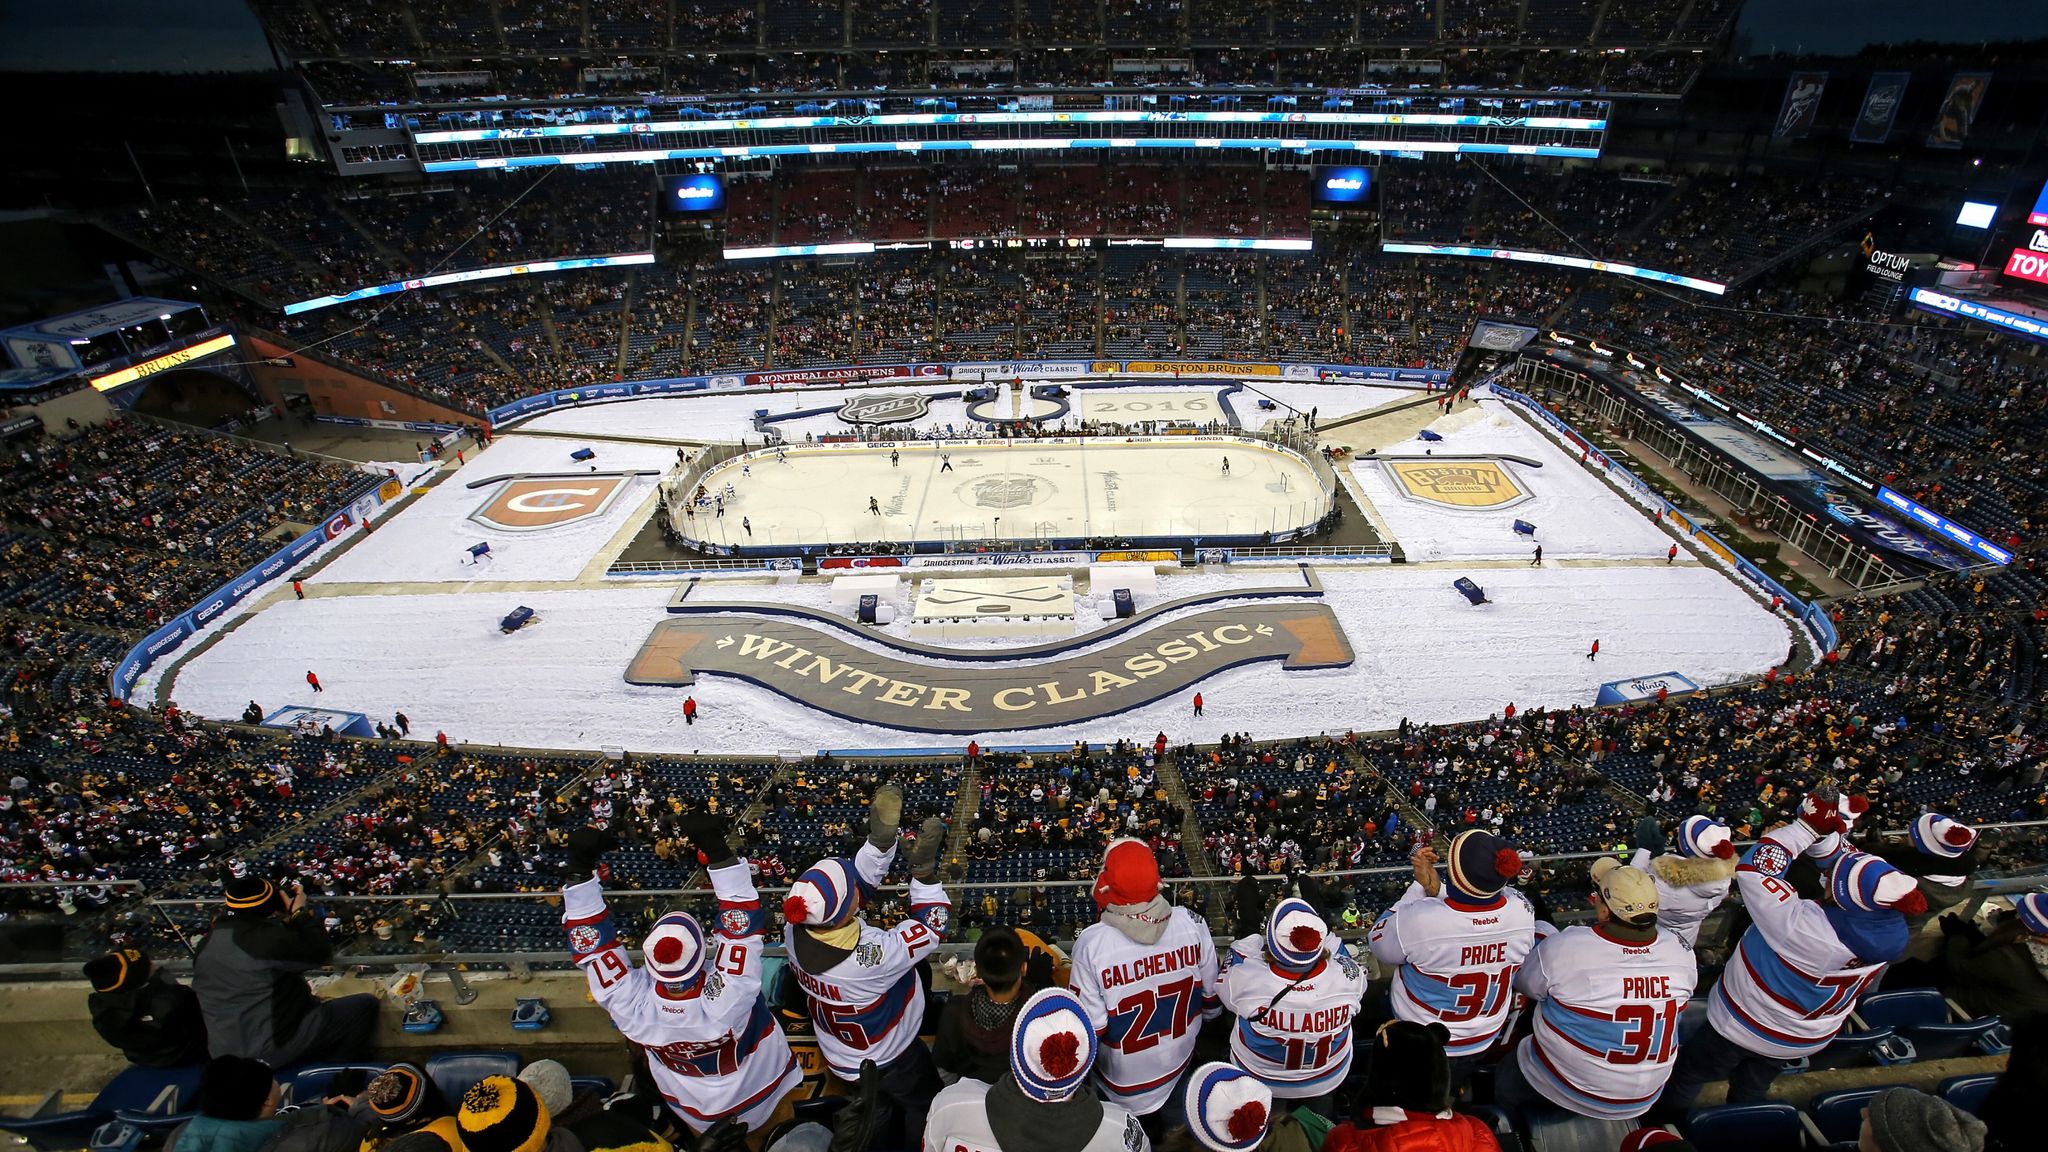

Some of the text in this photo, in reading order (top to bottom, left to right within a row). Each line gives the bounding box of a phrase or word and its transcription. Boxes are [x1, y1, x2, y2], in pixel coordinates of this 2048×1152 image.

[1871, 250, 1910, 272] OPTUM
[1866, 264, 1903, 281] FIELD LOUNGE
[134, 350, 191, 378] BRUINS
[1010, 362, 1044, 374] Winter
[1154, 363, 1253, 374] BOSTON BRUINS
[758, 367, 896, 384] MONTREAL CANADIENS
[857, 399, 912, 417] NHL
[1094, 398, 1209, 413] 2016
[715, 457, 738, 472] DISCOVER
[1408, 468, 1498, 487] BOSTON
[1833, 504, 1931, 553] OPTUM
[262, 558, 286, 577] Reebok
[923, 554, 1075, 567] BRIDGESTONE Winter CLASSIC
[197, 599, 224, 621] GEICO
[147, 627, 183, 655] BRIDGESTONE
[125, 659, 141, 683] Reebok
[734, 622, 1258, 713] WINTER CLASSIC
[1631, 680, 1671, 694] Winter
[1472, 916, 1499, 926] Reebok
[900, 923, 931, 959] 76
[1623, 947, 1651, 955] Reebok
[715, 943, 748, 976] 67
[1460, 942, 1507, 966] PRICE
[592, 949, 629, 990] 67
[1439, 965, 1513, 1022] 31
[1623, 976, 1672, 999] PRICE
[662, 1004, 686, 1015] Reebok
[1118, 976, 1194, 1055] 27
[1258, 1004, 1350, 1033] GALLAGHER
[1606, 999, 1678, 1064] 31
[1284, 1034, 1334, 1070] 11
